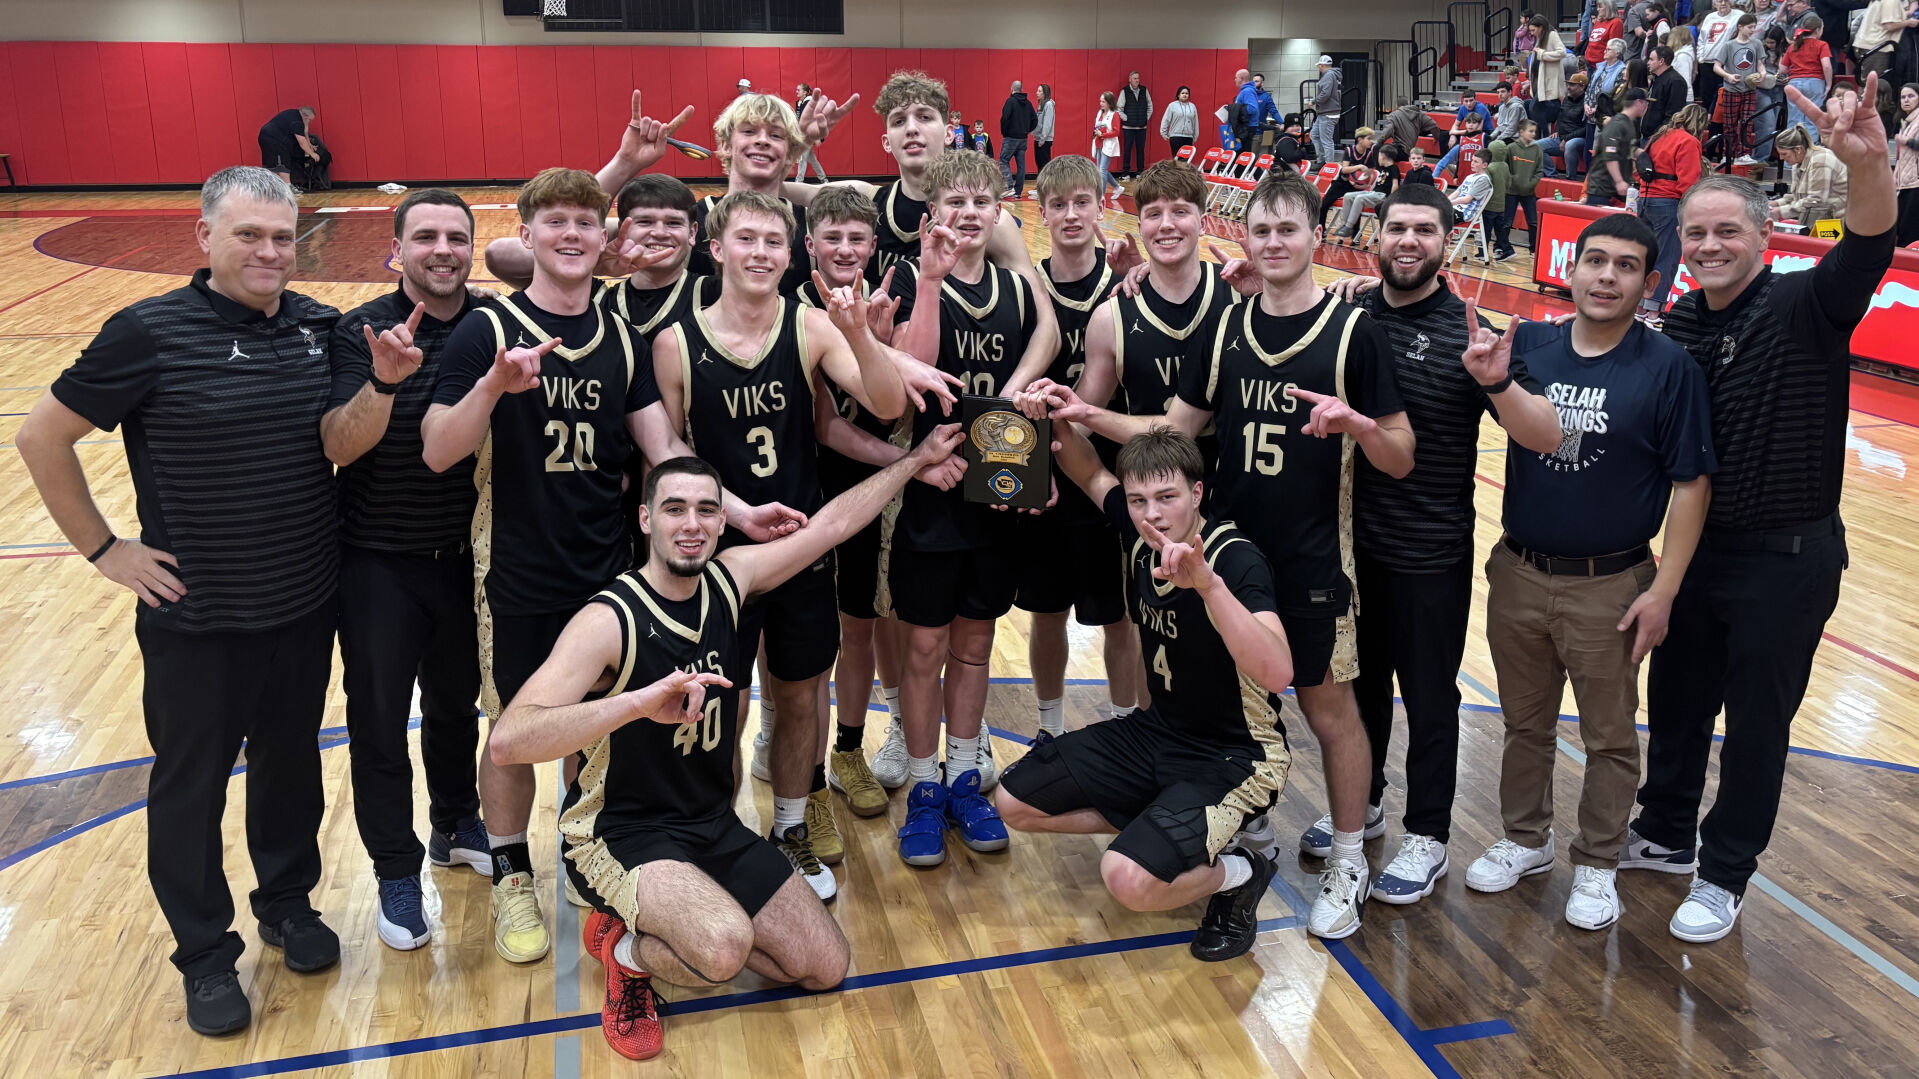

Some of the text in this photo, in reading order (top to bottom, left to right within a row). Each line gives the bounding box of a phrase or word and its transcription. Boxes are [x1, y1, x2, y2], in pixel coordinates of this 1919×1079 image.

[1708, 22, 1727, 43] P
[955, 329, 1005, 362] VIKS
[542, 376, 602, 411] VIKS
[722, 380, 786, 419] VIKS
[1240, 378, 1299, 414] VIKS
[1549, 382, 1607, 411] SELAH
[1555, 406, 1609, 435] KINGS
[544, 420, 598, 473] 20
[746, 425, 778, 478] 3
[1242, 421, 1287, 476] 15
[1538, 448, 1606, 472] SKETBALL
[1152, 643, 1172, 692] 4
[673, 696, 722, 757] 40
